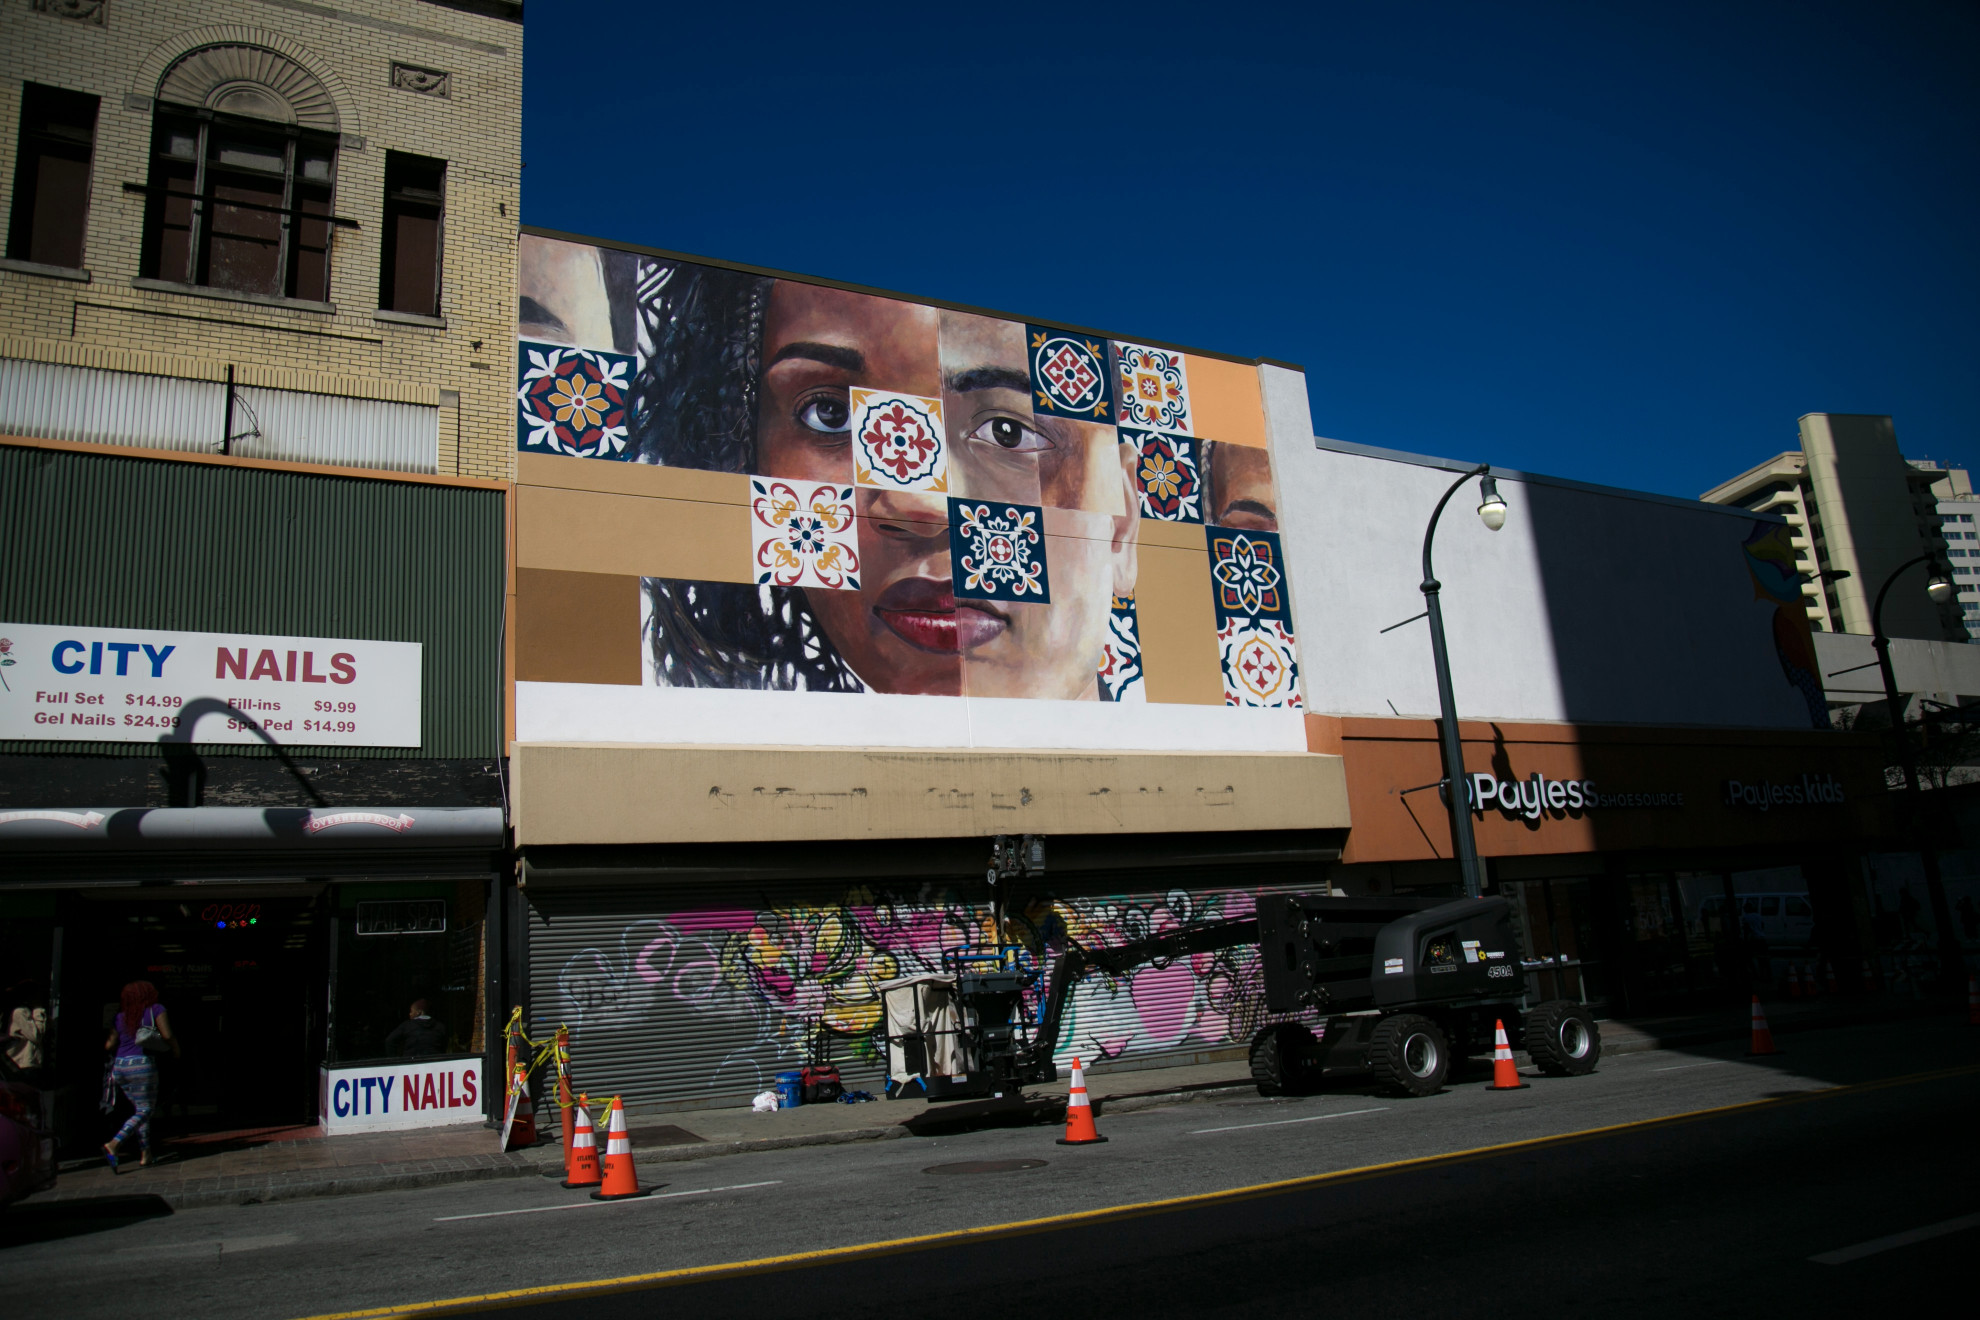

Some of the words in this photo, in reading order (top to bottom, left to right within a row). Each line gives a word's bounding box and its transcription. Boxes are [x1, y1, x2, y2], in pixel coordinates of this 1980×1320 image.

[52, 640, 176, 677] CITY
[216, 647, 356, 684] NAILS
[36, 691, 68, 703] Full
[74, 692, 104, 705] Set
[125, 693, 182, 707] $14.99
[227, 698, 281, 711] Fill-ins
[314, 700, 356, 713] $9.99
[34, 712, 64, 724] Gel
[71, 713, 115, 726] Nails
[124, 714, 181, 728] $24.99
[227, 718, 258, 732] Spa
[263, 719, 293, 731] Ped
[303, 719, 356, 732] $14.99
[1472, 773, 1600, 819] Payless
[1600, 792, 1684, 808] SHOESOURCE
[1727, 779, 1804, 812] Payless
[1801, 772, 1846, 804] kids
[375, 815, 402, 829] DOOR
[201, 904, 261, 928] open
[359, 904, 403, 932] NAIL
[408, 903, 442, 930] SPA
[1487, 965, 1514, 978] 450A
[333, 1076, 394, 1118] CITY
[403, 1070, 477, 1111] NAILS
